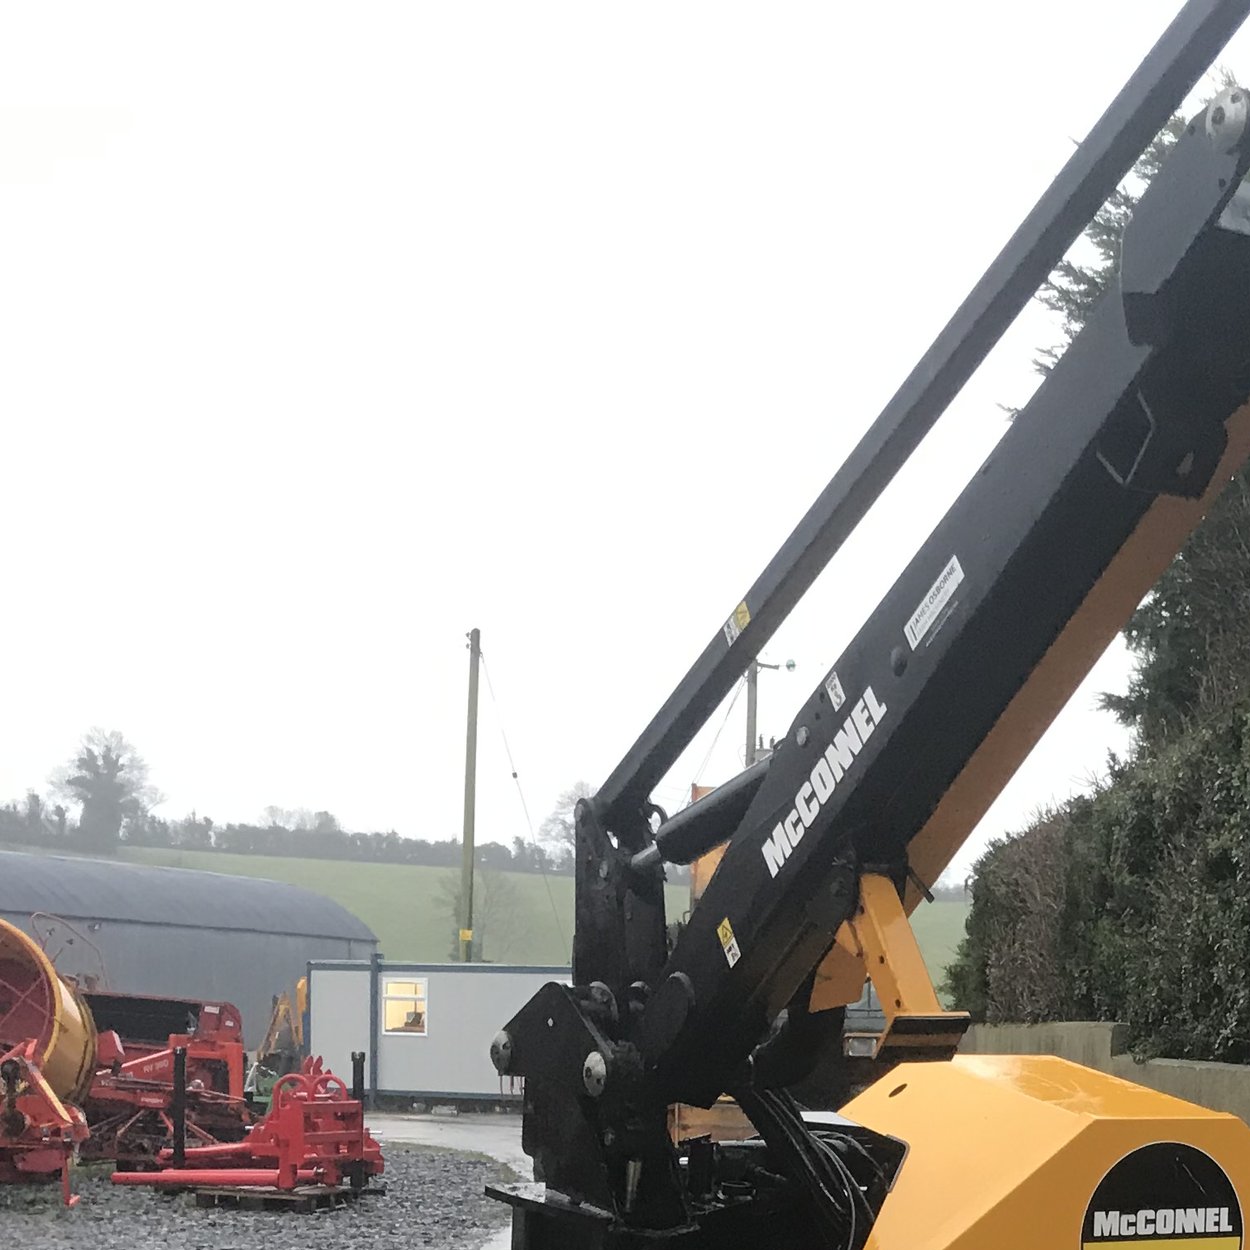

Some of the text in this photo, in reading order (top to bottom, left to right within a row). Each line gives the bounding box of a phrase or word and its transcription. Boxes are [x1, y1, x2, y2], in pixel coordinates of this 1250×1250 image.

[912, 603, 930, 628] JAMES
[928, 563, 957, 605] OSBORNE
[761, 685, 888, 879] McCONNEL
[1093, 1207, 1233, 1237] McCONNEL
